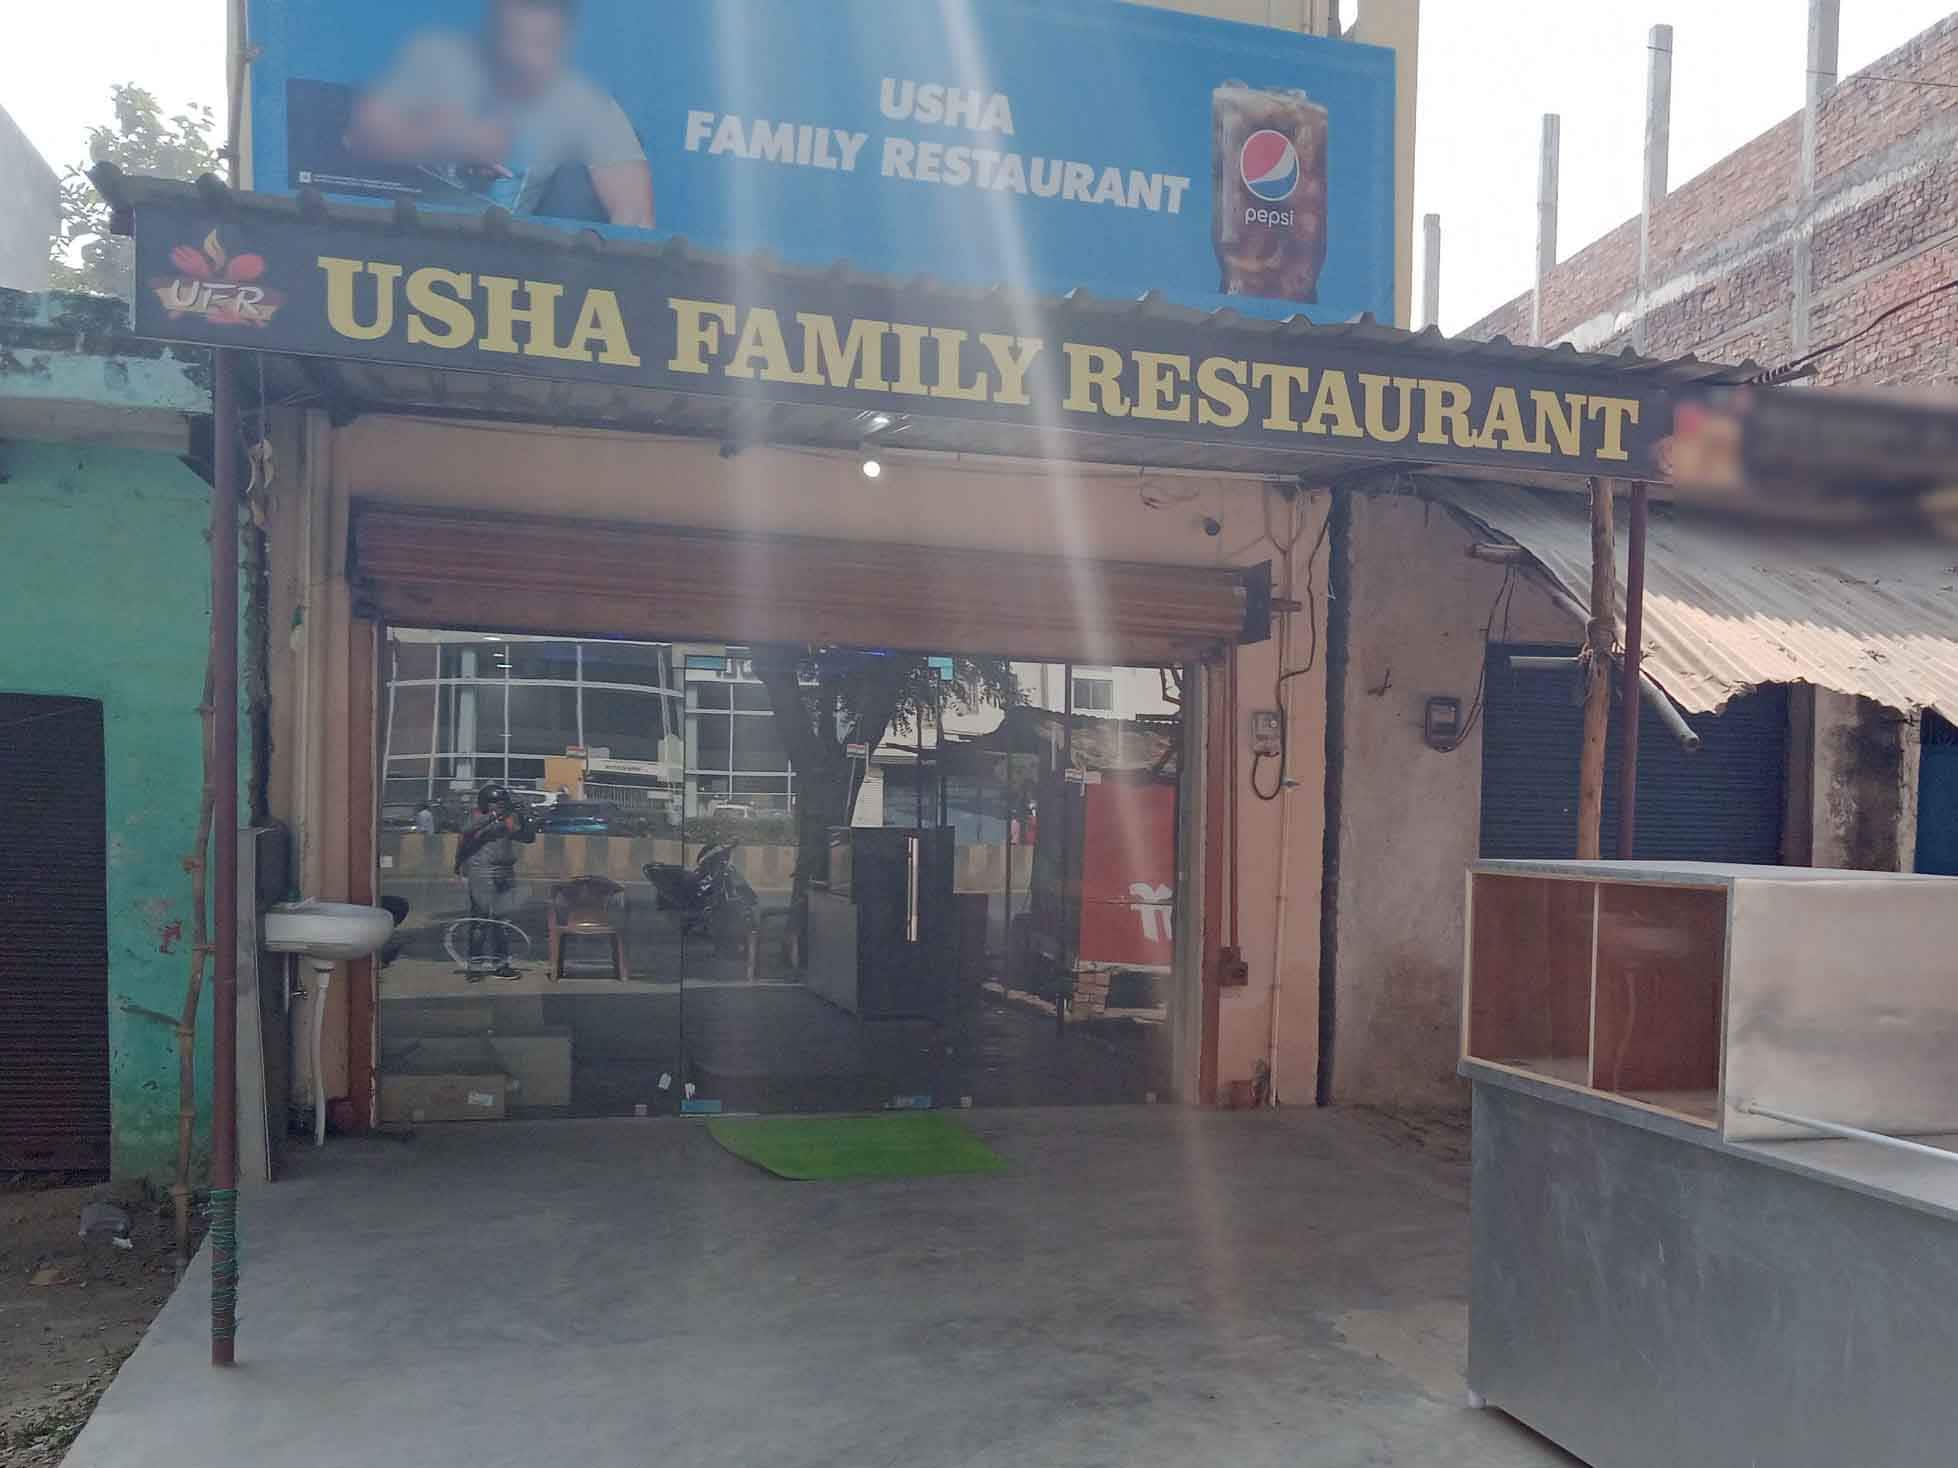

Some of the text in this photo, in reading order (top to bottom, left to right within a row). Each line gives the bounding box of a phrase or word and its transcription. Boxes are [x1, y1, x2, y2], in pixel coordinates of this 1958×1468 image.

[880, 78, 1014, 135] USHA
[685, 110, 1191, 214] FAMILY RESTAURANT
[1244, 207, 1295, 228] pepsi
[169, 279, 264, 320] UFR
[317, 256, 1640, 461] USHA FAMILY RESTAURANT
